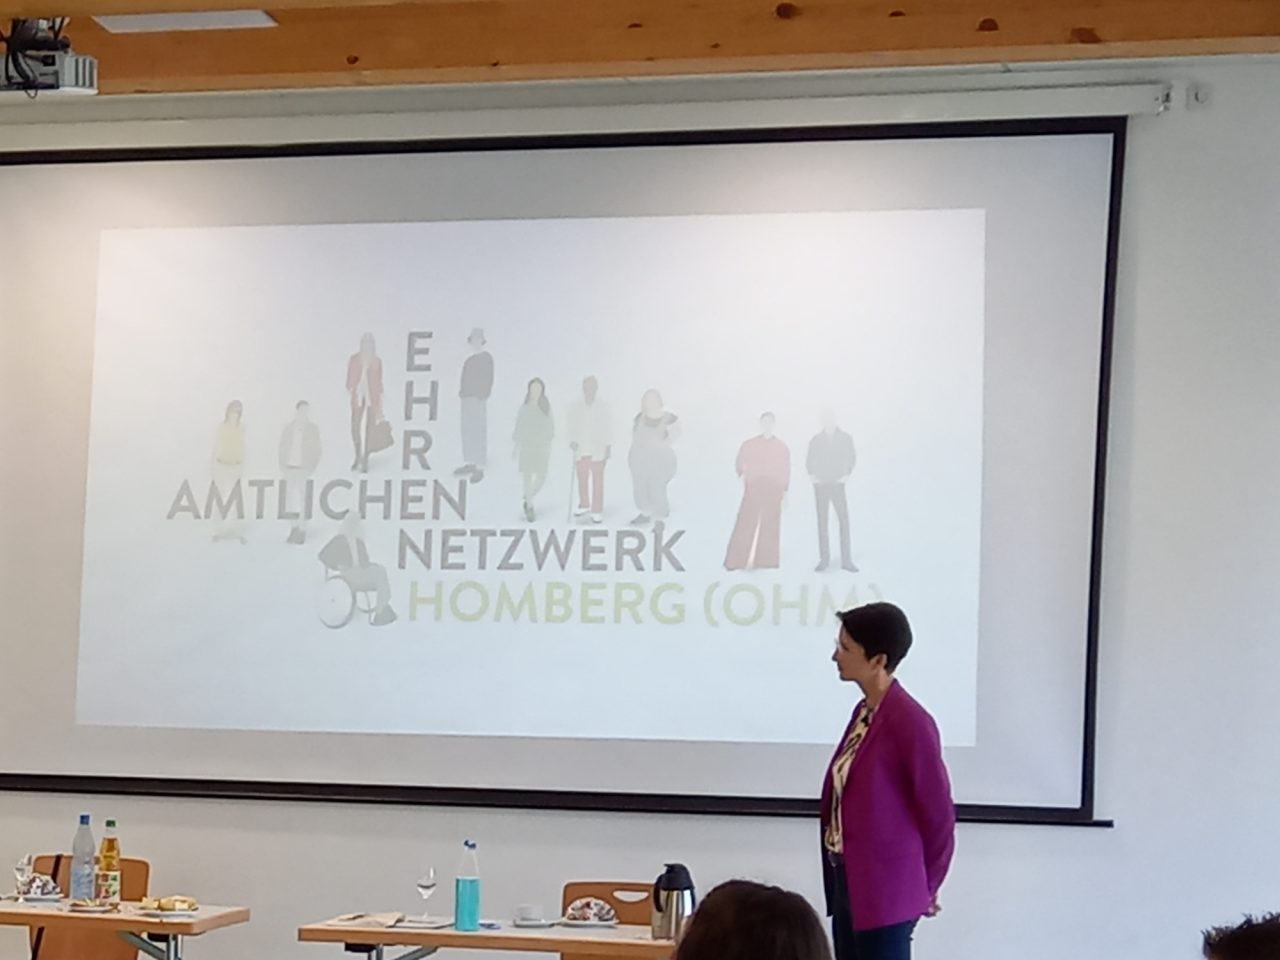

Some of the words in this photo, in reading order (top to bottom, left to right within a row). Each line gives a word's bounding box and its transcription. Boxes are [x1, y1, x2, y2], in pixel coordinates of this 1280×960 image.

[166, 478, 468, 521] AMTLICHEN
[398, 527, 686, 572] NETZWERK
[408, 579, 686, 625] HOMBERG
